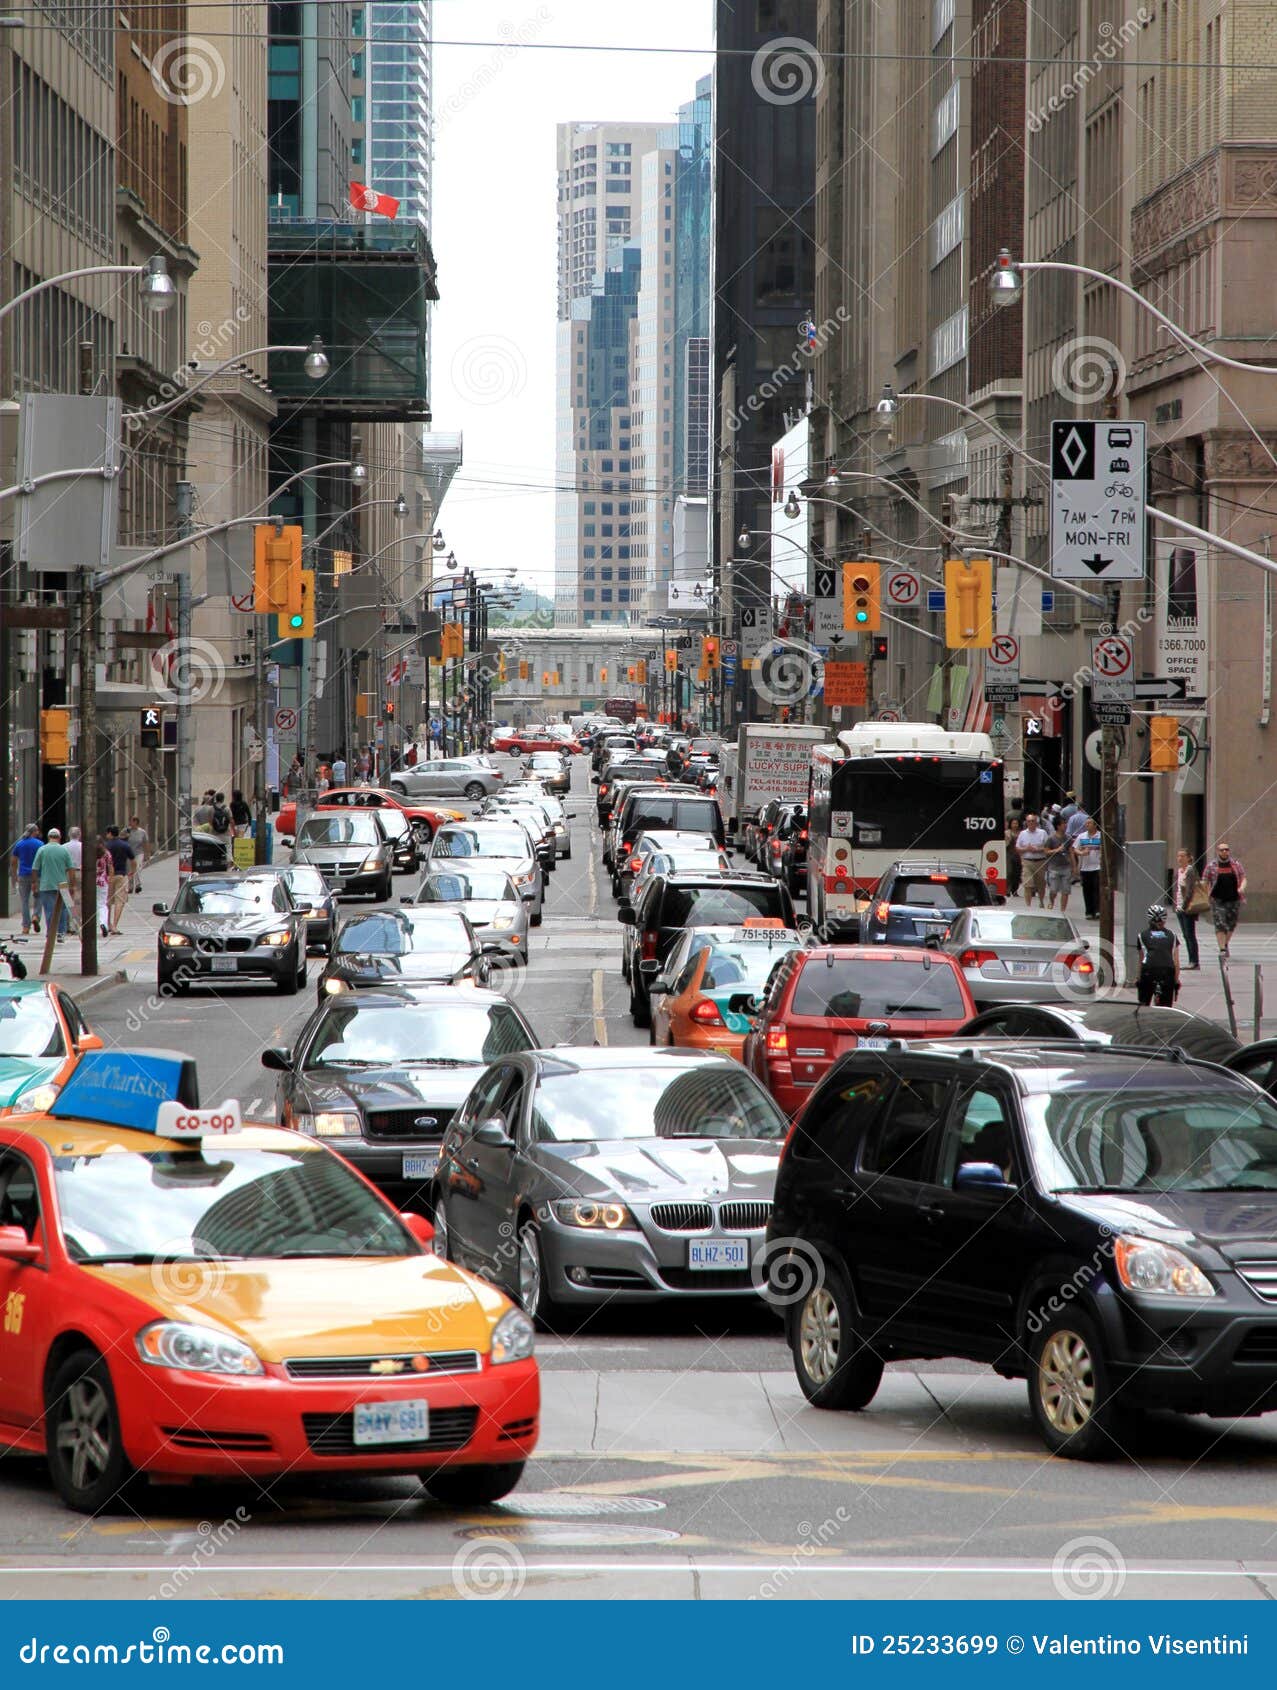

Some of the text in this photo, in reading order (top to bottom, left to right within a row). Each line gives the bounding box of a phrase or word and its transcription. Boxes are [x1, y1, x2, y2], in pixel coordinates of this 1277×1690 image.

[1065, 531, 1130, 546] MON-FRI
[1167, 614, 1199, 627] SMITH
[821, 623, 844, 631] MON-
[1164, 639, 1206, 651] 366.7000
[749, 761, 809, 771] LUCKY SUPP
[963, 817, 996, 830] 1570
[742, 929, 787, 939] 751-5555
[176, 1115, 234, 1134] co-op
